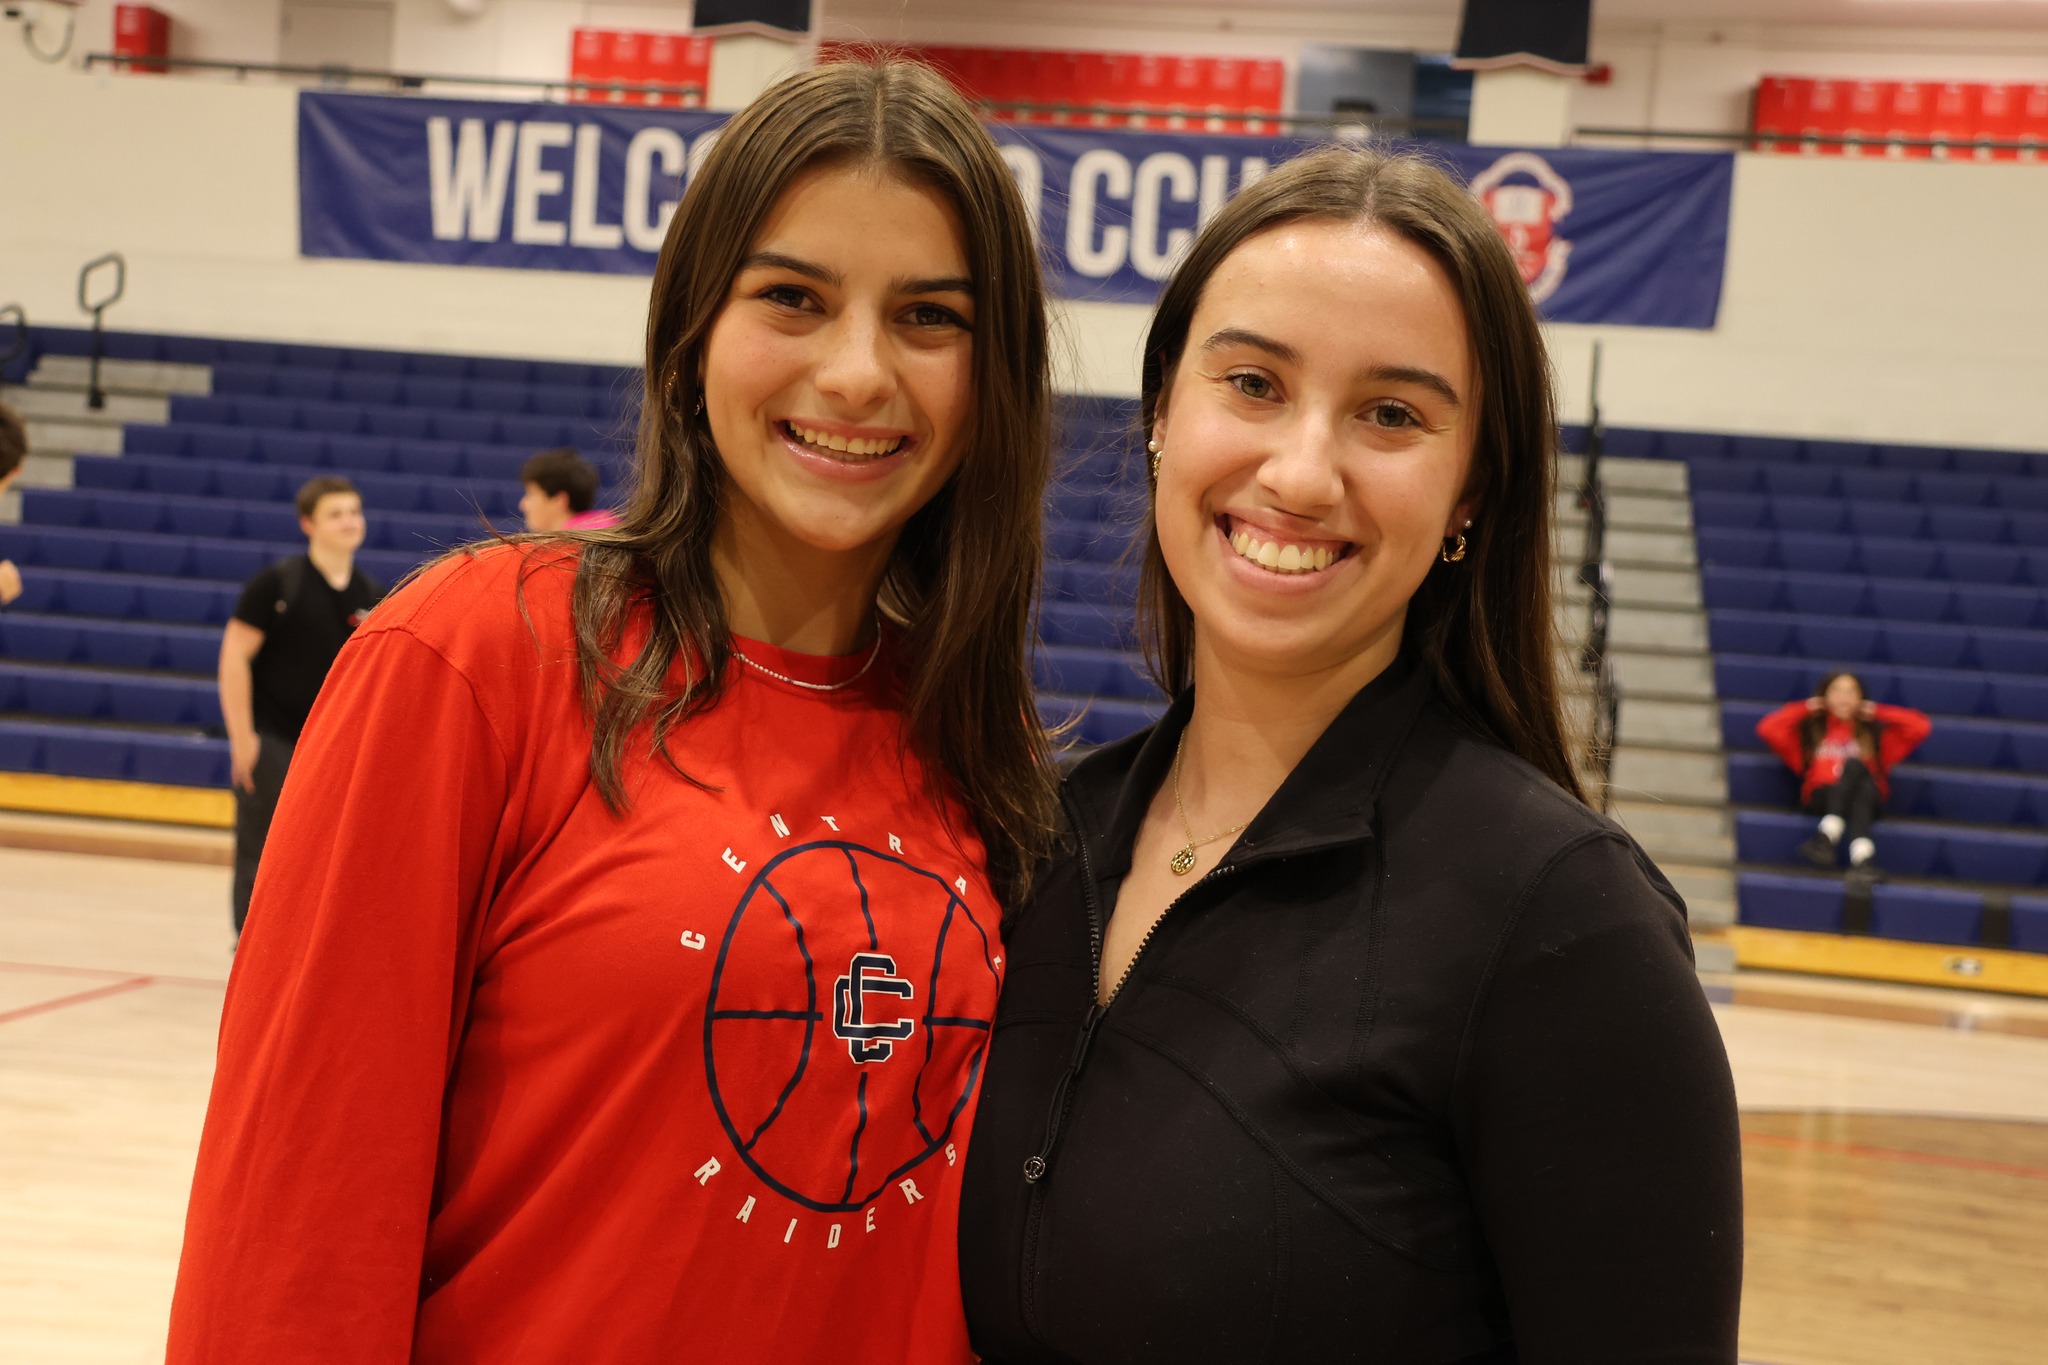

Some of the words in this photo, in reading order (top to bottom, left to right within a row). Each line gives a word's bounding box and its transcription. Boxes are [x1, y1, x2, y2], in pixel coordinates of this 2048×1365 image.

[426, 117, 719, 252] WELC
[680, 813, 1003, 970] CENTRAL
[693, 1143, 957, 1249] RAIDERS
